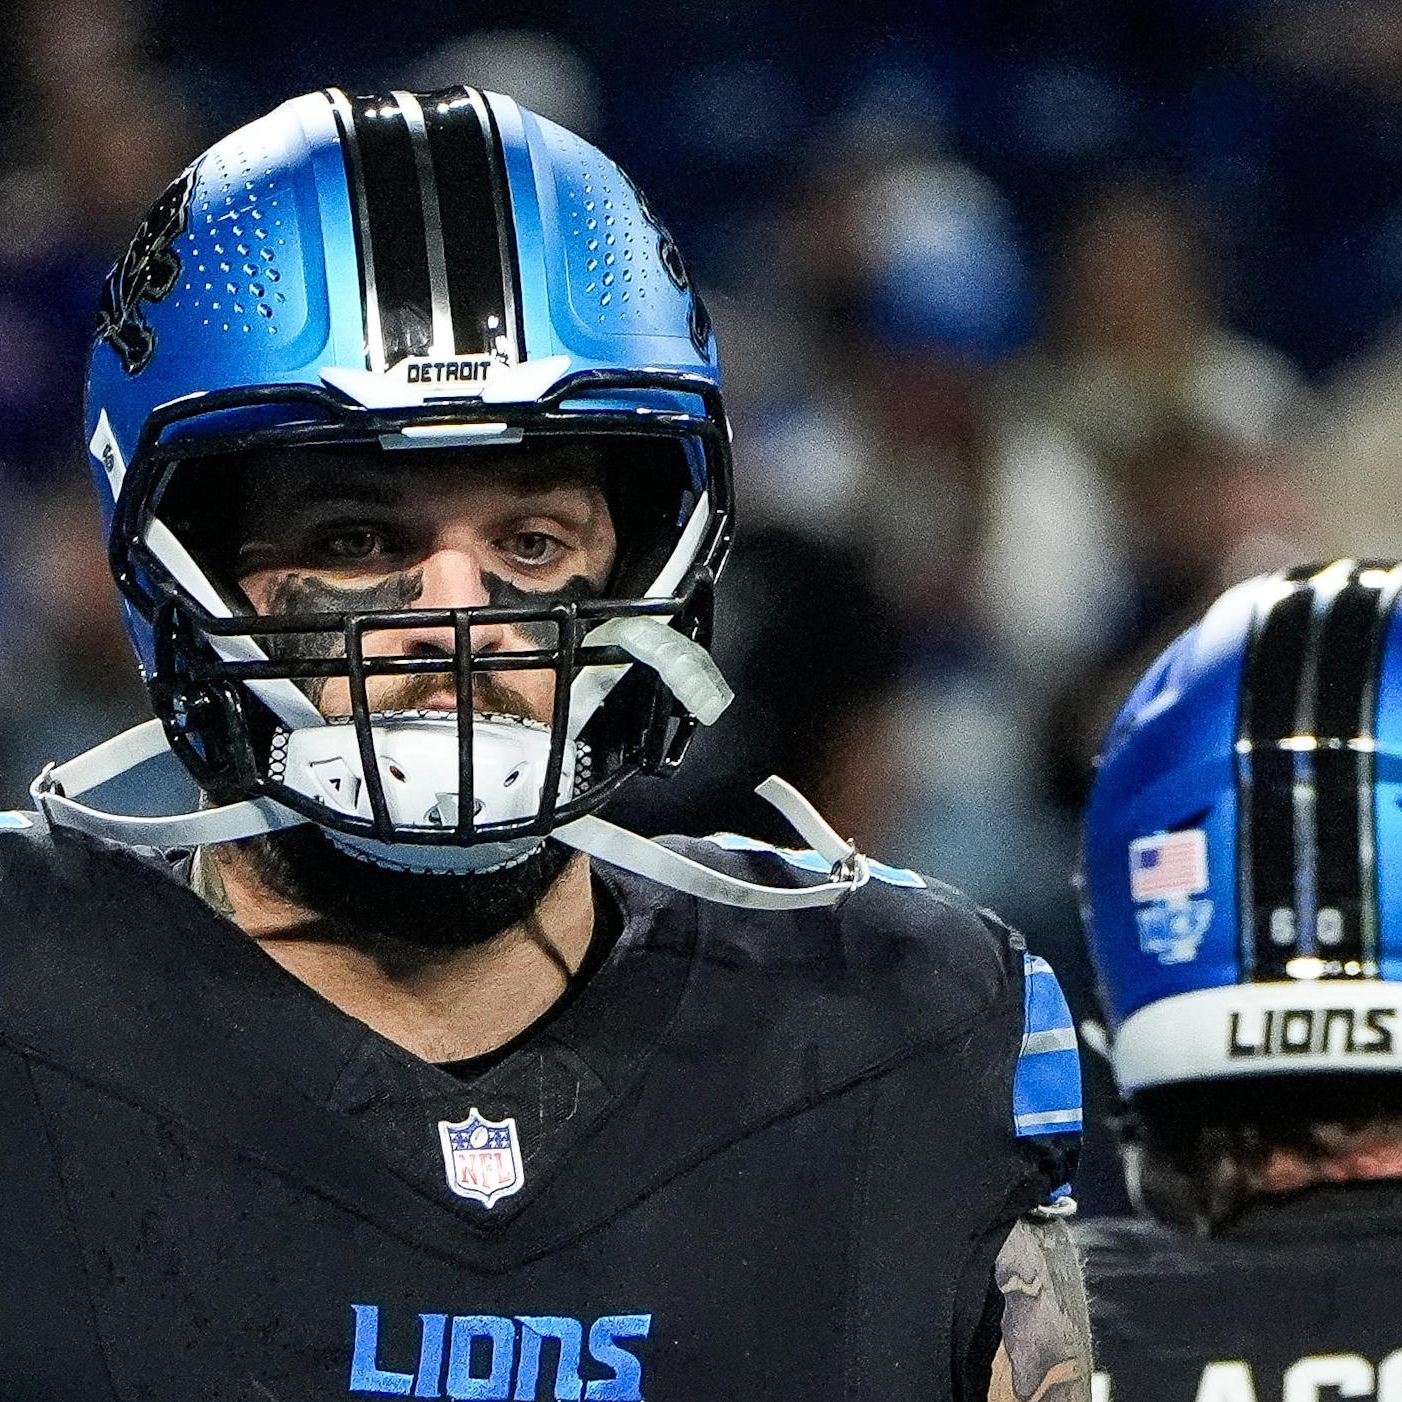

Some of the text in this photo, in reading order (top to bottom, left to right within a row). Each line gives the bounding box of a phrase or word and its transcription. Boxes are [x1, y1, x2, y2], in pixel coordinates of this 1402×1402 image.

[407, 361, 491, 383] DETROIT
[1228, 1008, 1397, 1058] LIONS
[458, 1152, 512, 1189] NFL
[349, 1304, 653, 1402] LIONS
